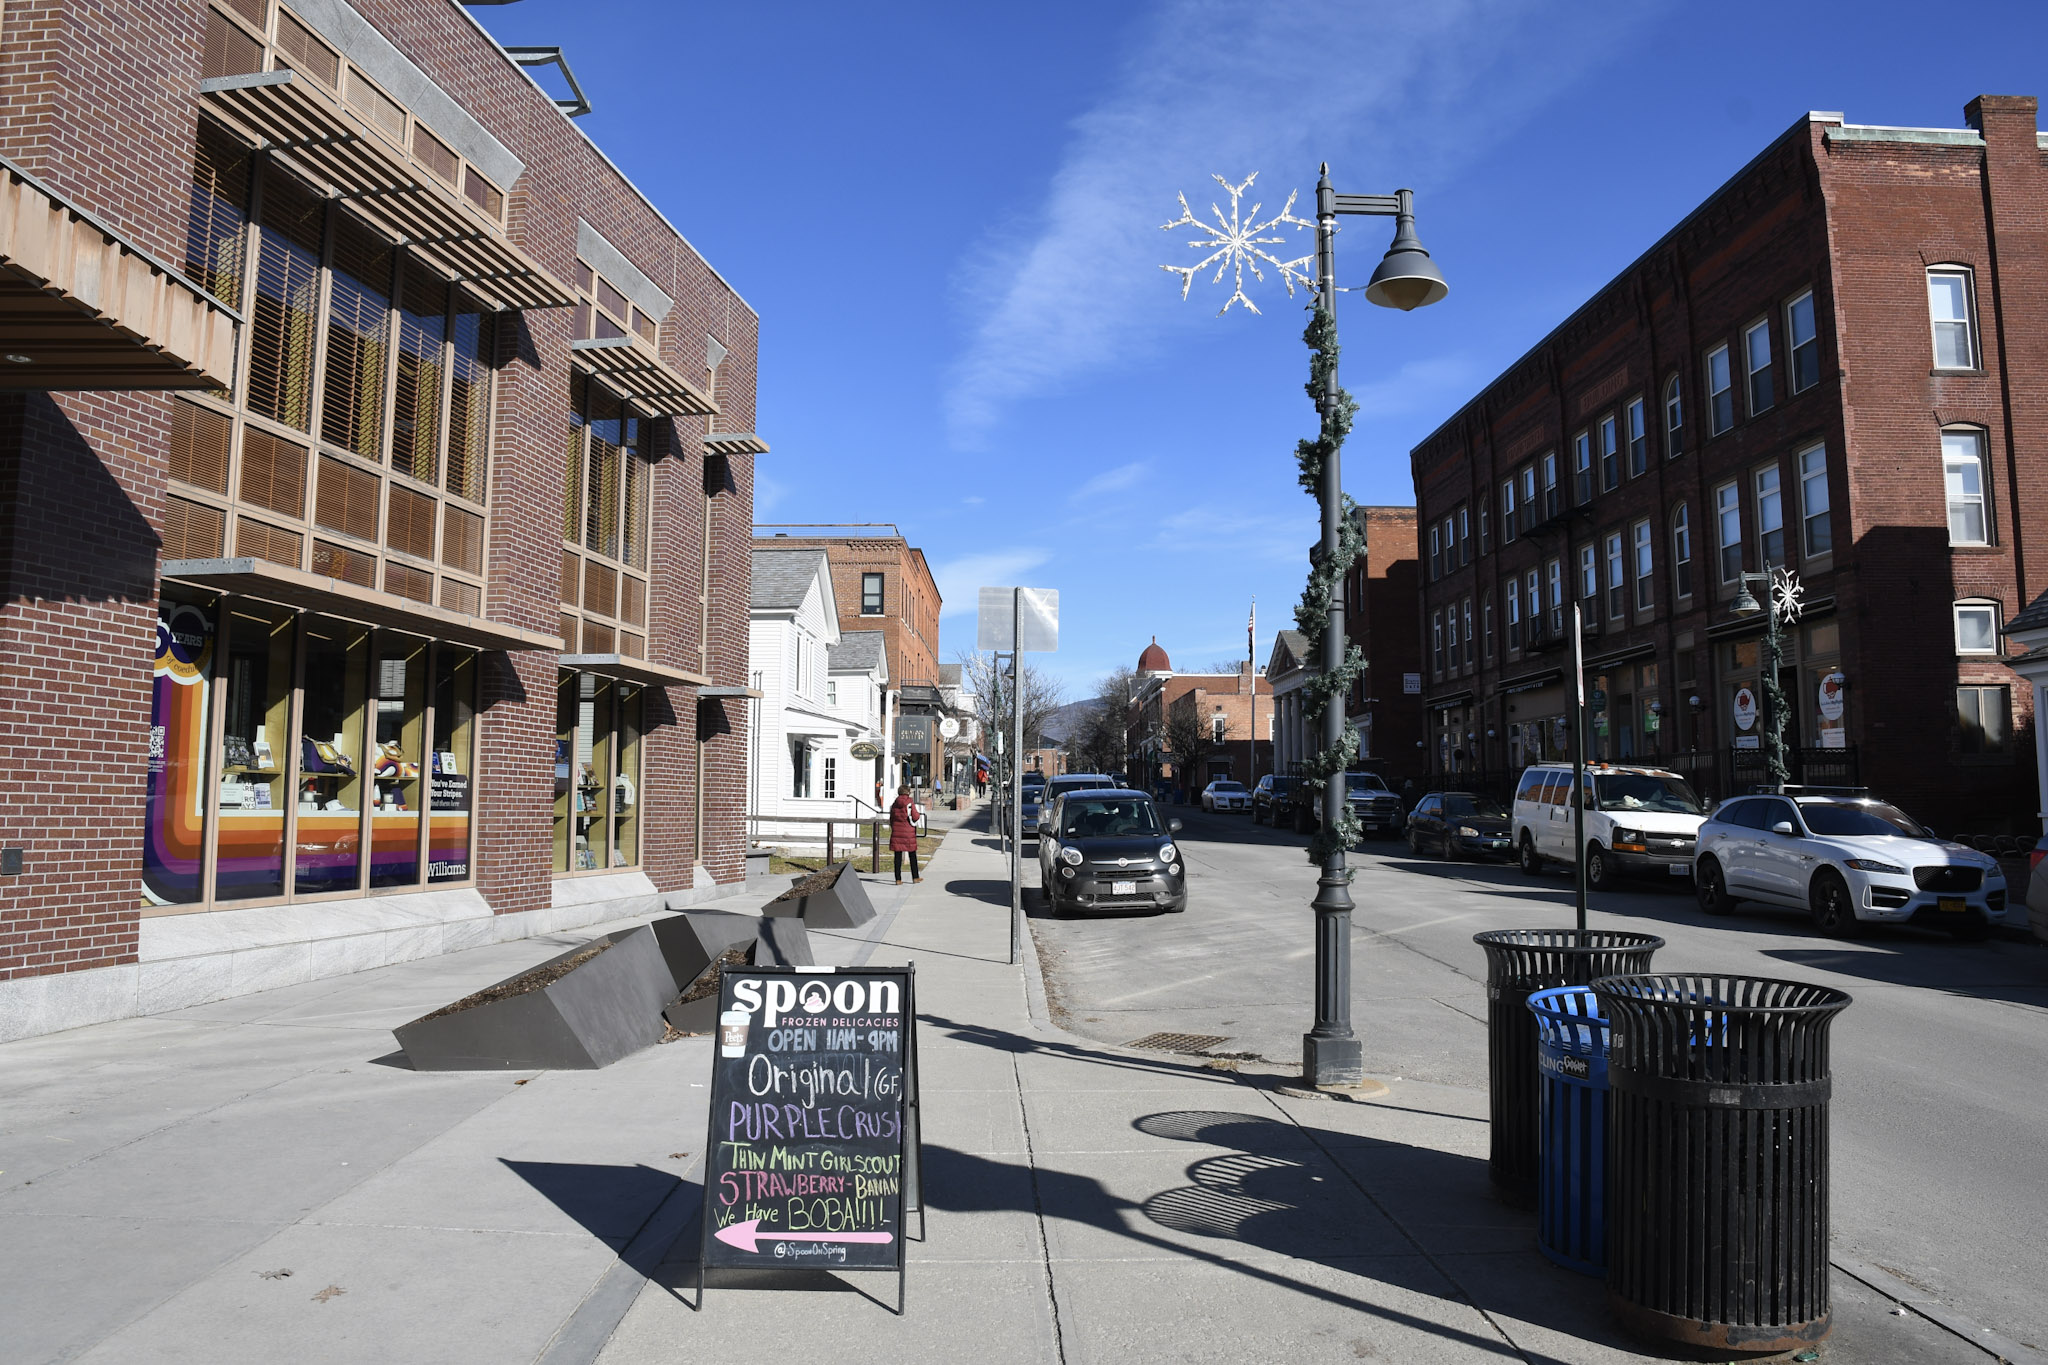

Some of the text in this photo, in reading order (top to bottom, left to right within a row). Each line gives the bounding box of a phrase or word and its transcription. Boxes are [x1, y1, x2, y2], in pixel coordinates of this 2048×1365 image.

[731, 979, 900, 1028] spoon
[781, 1017, 899, 1027] FROZEN DELICACIES
[767, 1027, 817, 1052] OPEN
[748, 1053, 870, 1109] Original
[713, 1205, 736, 1228] We
[744, 1202, 779, 1223] Have
